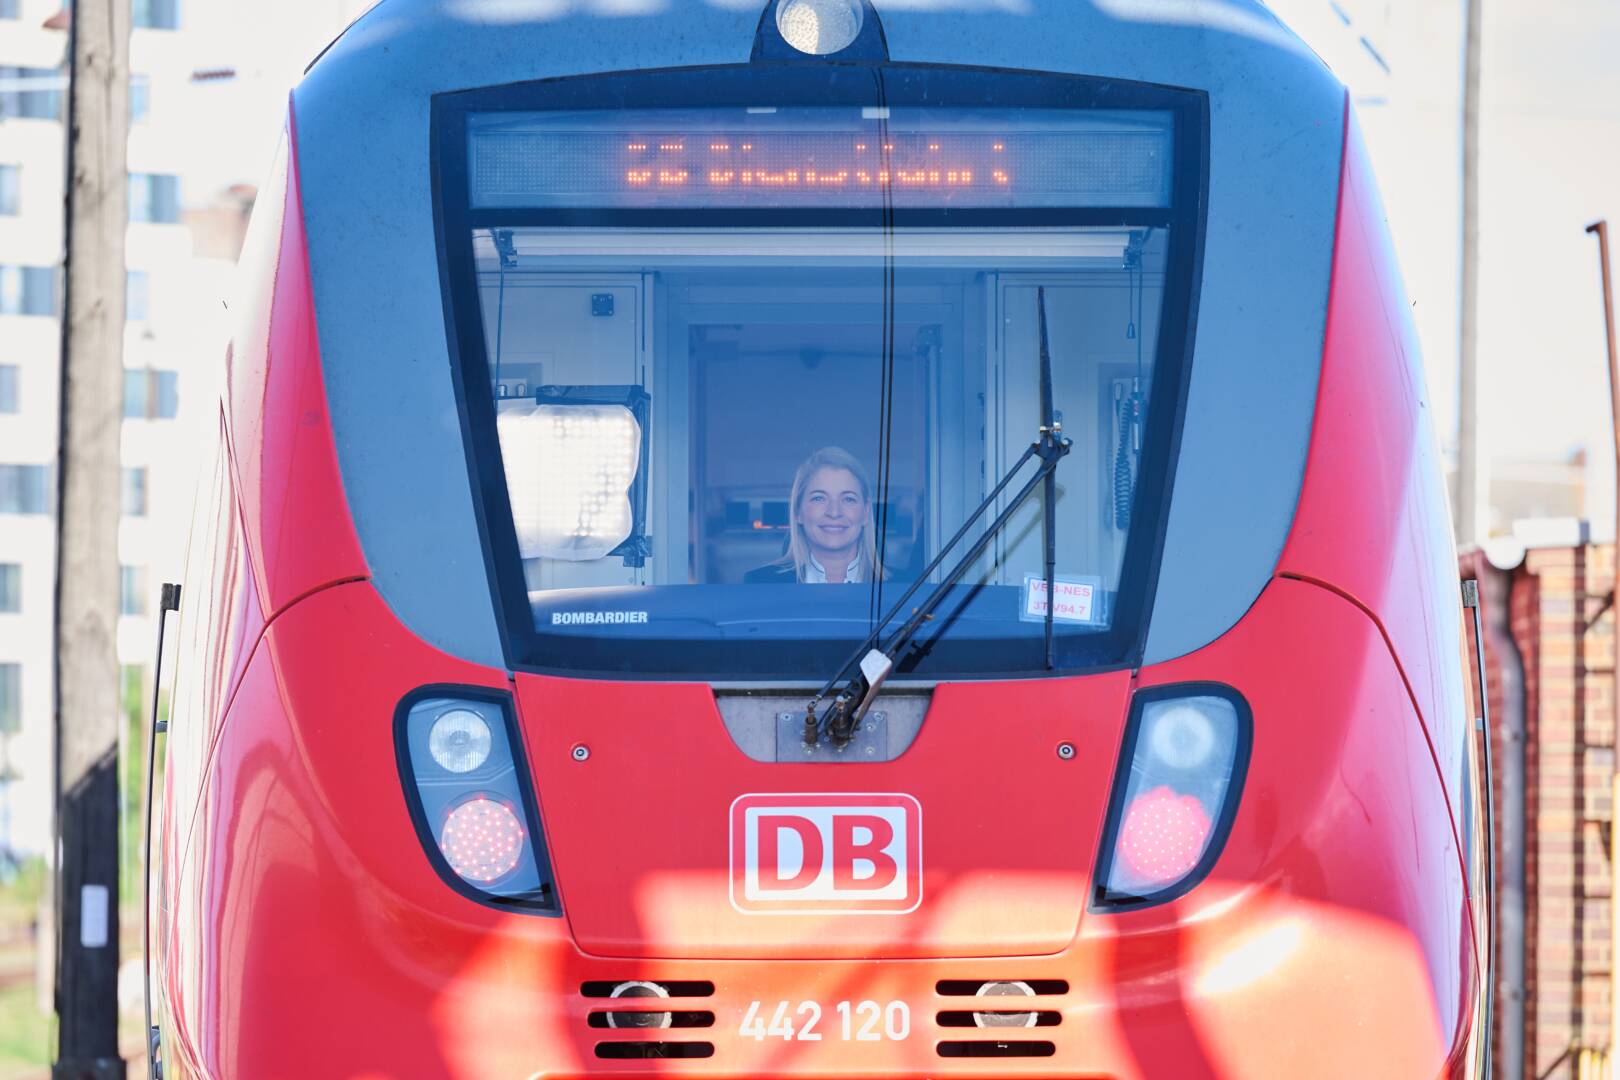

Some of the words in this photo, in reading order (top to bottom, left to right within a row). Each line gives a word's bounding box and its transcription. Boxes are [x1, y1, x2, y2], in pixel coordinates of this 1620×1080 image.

[551, 611, 648, 624] BOMBARDIER
[757, 814, 898, 891] DB
[738, 1000, 822, 1041] 442
[836, 1000, 911, 1041] 120
